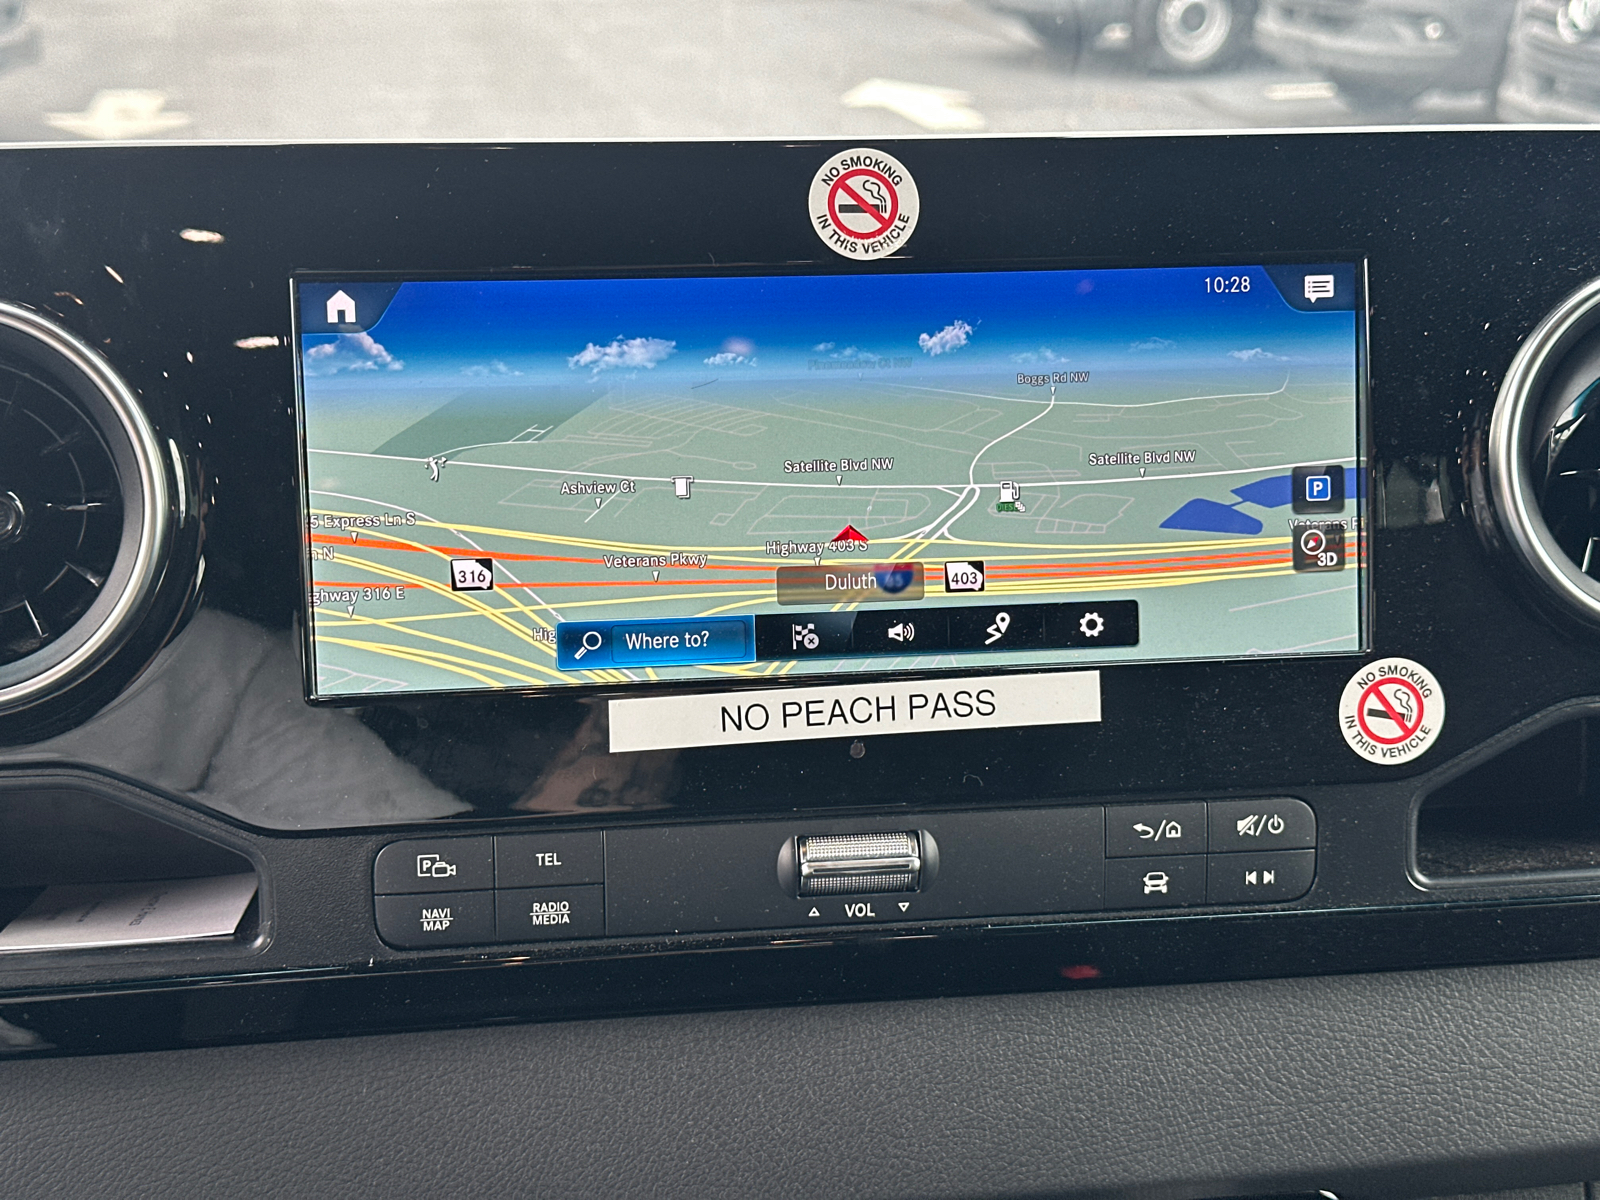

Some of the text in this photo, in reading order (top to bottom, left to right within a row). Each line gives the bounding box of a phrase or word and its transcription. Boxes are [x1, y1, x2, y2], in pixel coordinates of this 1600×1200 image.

[821, 156, 903, 187] NO SMOKING
[816, 213, 910, 254] IN THIS VEHICLE
[1204, 276, 1251, 293] 10:28
[1017, 371, 1090, 386] Boggs Rd NW
[1088, 450, 1196, 465] Satellite Blvd NW
[784, 458, 894, 473] Satellite Blvd NW
[560, 480, 636, 495] Ashview Ct
[324, 514, 380, 530] Express
[385, 513, 402, 526] Ln
[406, 512, 416, 525] S
[323, 547, 334, 560] N
[766, 541, 824, 557] Highway
[828, 539, 855, 552] 403
[603, 552, 708, 568] Veterans Pkwy
[1317, 552, 1338, 566] 3D
[458, 570, 486, 584] 316
[825, 573, 877, 591] Duluth
[951, 571, 978, 585] 403
[363, 587, 391, 600] 316
[396, 586, 405, 599] E
[625, 630, 710, 650] Where to?
[1357, 665, 1432, 699] NO SMOKING
[720, 689, 996, 732] NO PEACH PASS
[1344, 715, 1431, 758] IN THIS VEHICLE
[536, 853, 562, 866] TEL
[422, 908, 451, 919] NAVI
[533, 901, 570, 913] RADIO
[844, 903, 876, 918] VOL
[423, 920, 450, 931] MAP
[532, 914, 570, 925] MEDIA
